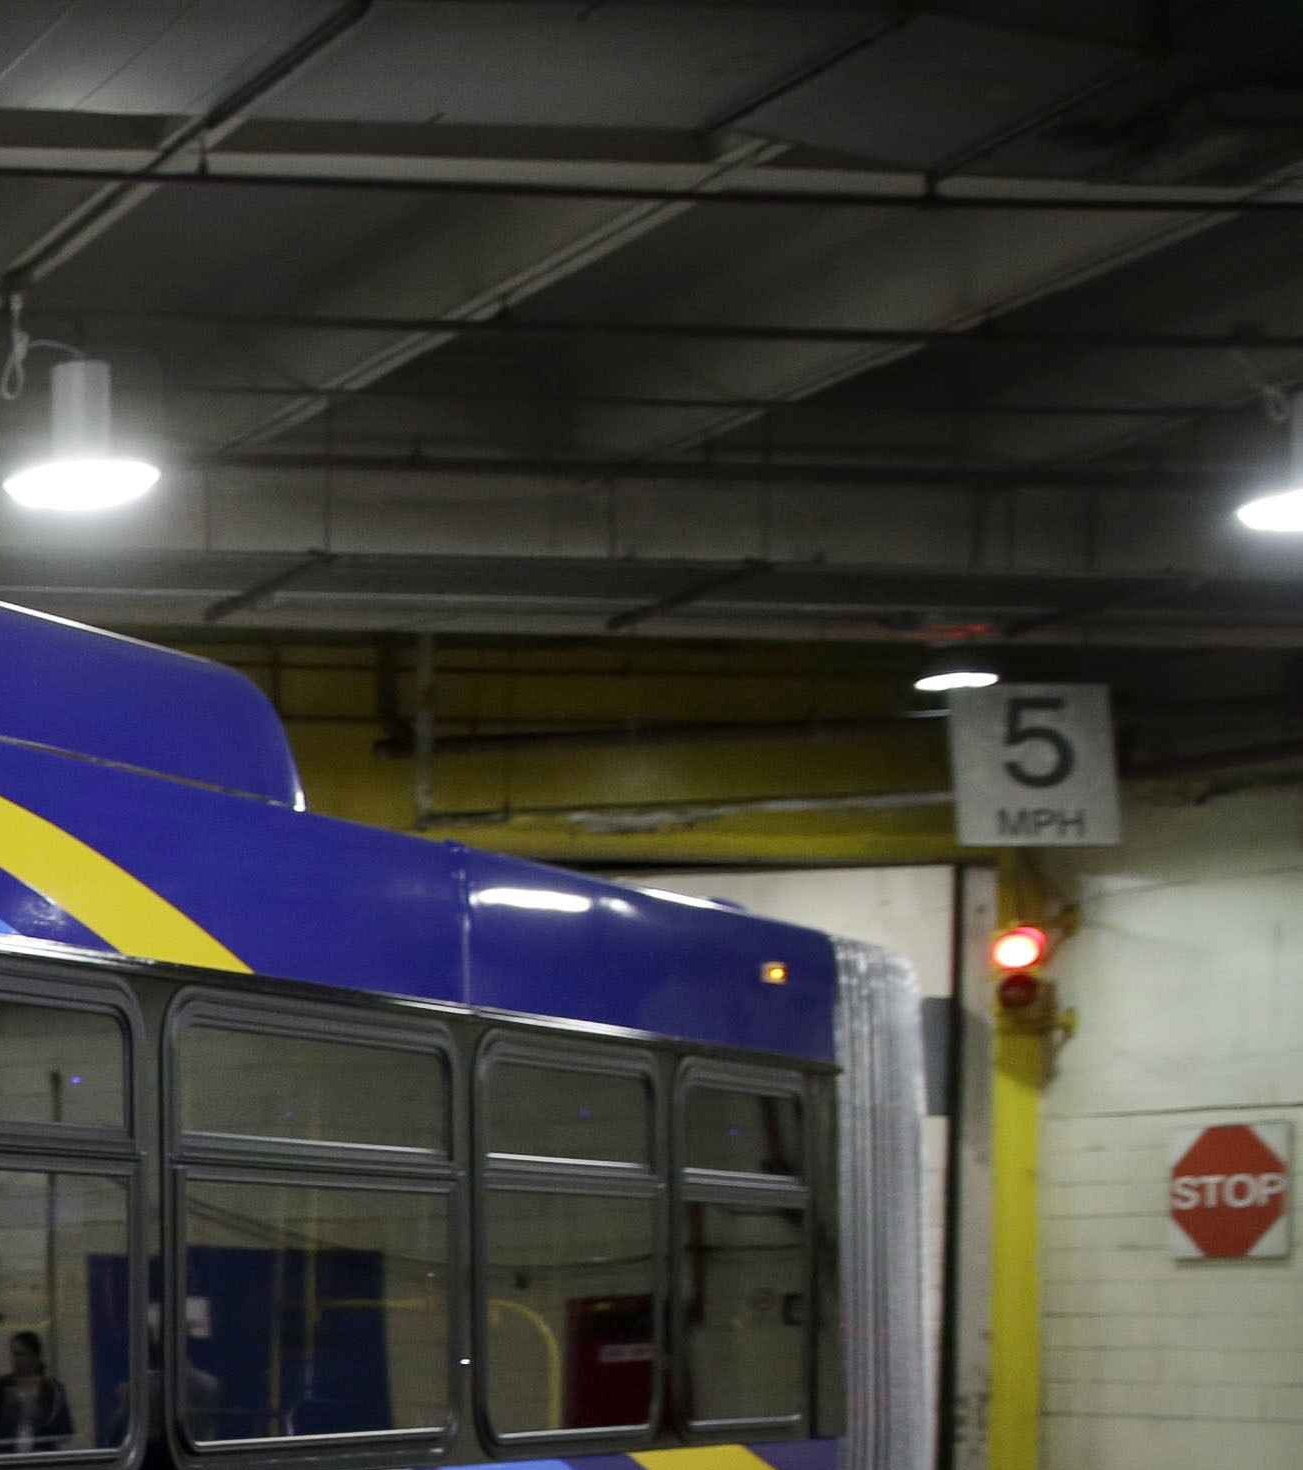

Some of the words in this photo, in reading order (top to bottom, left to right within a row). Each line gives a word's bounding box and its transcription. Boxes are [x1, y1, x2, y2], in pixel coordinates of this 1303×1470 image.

[1003, 697, 1075, 791] 5
[997, 808, 1087, 838] MPH
[1171, 1173, 1287, 1211] STOP
